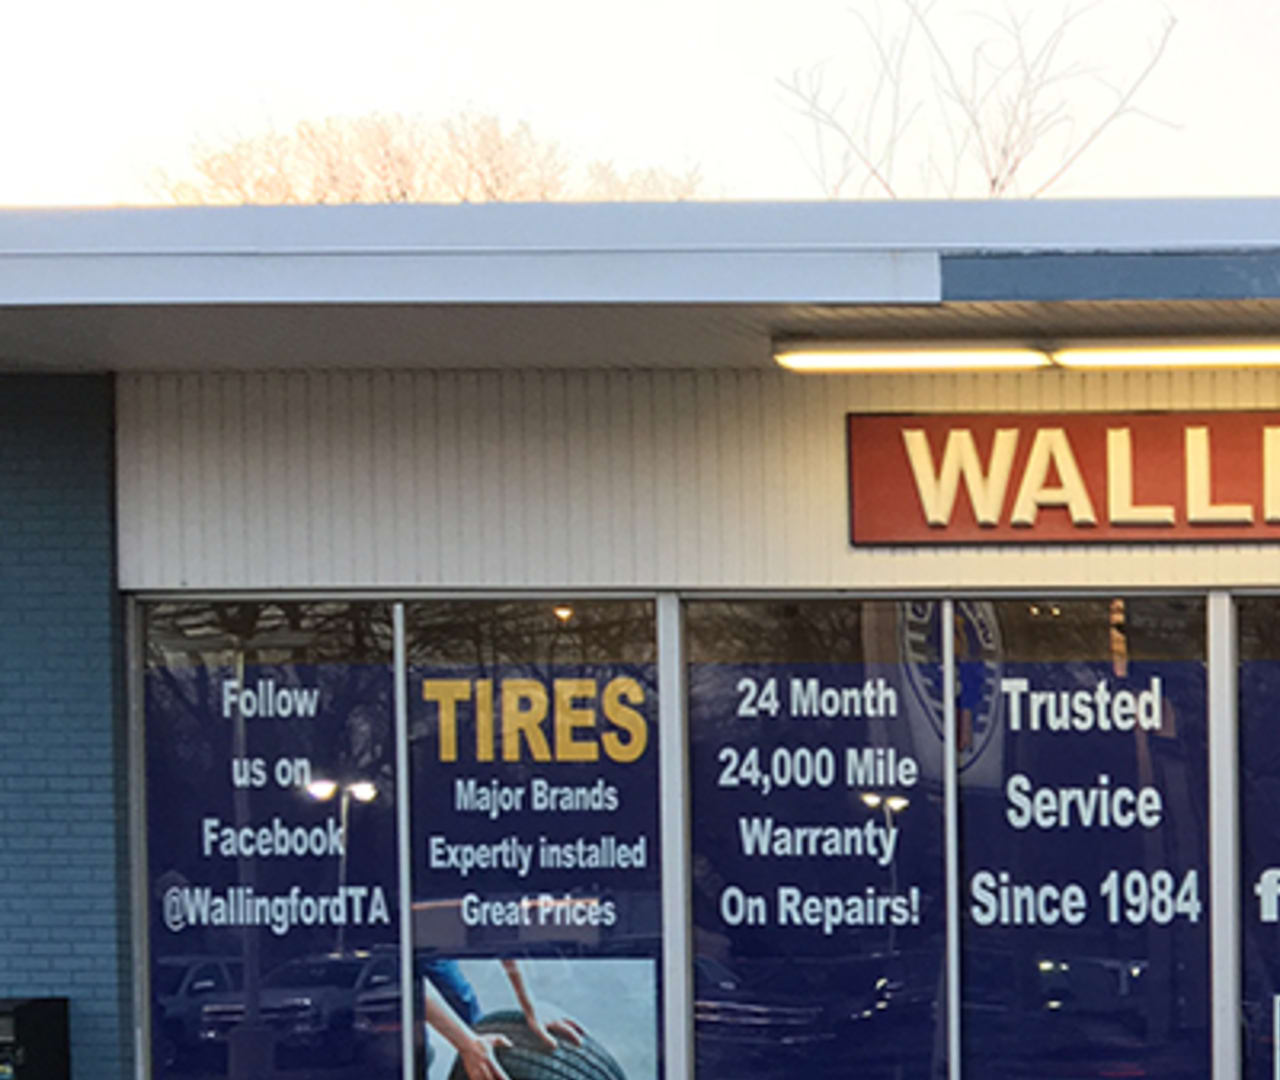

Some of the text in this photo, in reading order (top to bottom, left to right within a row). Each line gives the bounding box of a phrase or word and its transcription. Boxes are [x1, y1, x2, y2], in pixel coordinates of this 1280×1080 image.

[222, 680, 319, 718] Follow
[737, 678, 897, 716] 24 Month
[1001, 679, 1162, 731] Trusted
[423, 679, 649, 763] TIRES
[232, 759, 311, 787] us on
[719, 748, 917, 794] 24,000 Mile
[456, 780, 618, 818] Major Brands
[1007, 775, 1162, 828] Service
[203, 818, 345, 856] Facebook
[430, 837, 645, 876] Expertly installed
[740, 818, 897, 865] Warranty
[164, 886, 389, 935] @WallingfordTA
[461, 895, 616, 926] Great Prices
[722, 887, 918, 934] On Repairs!
[972, 870, 1200, 924] Since 1984
